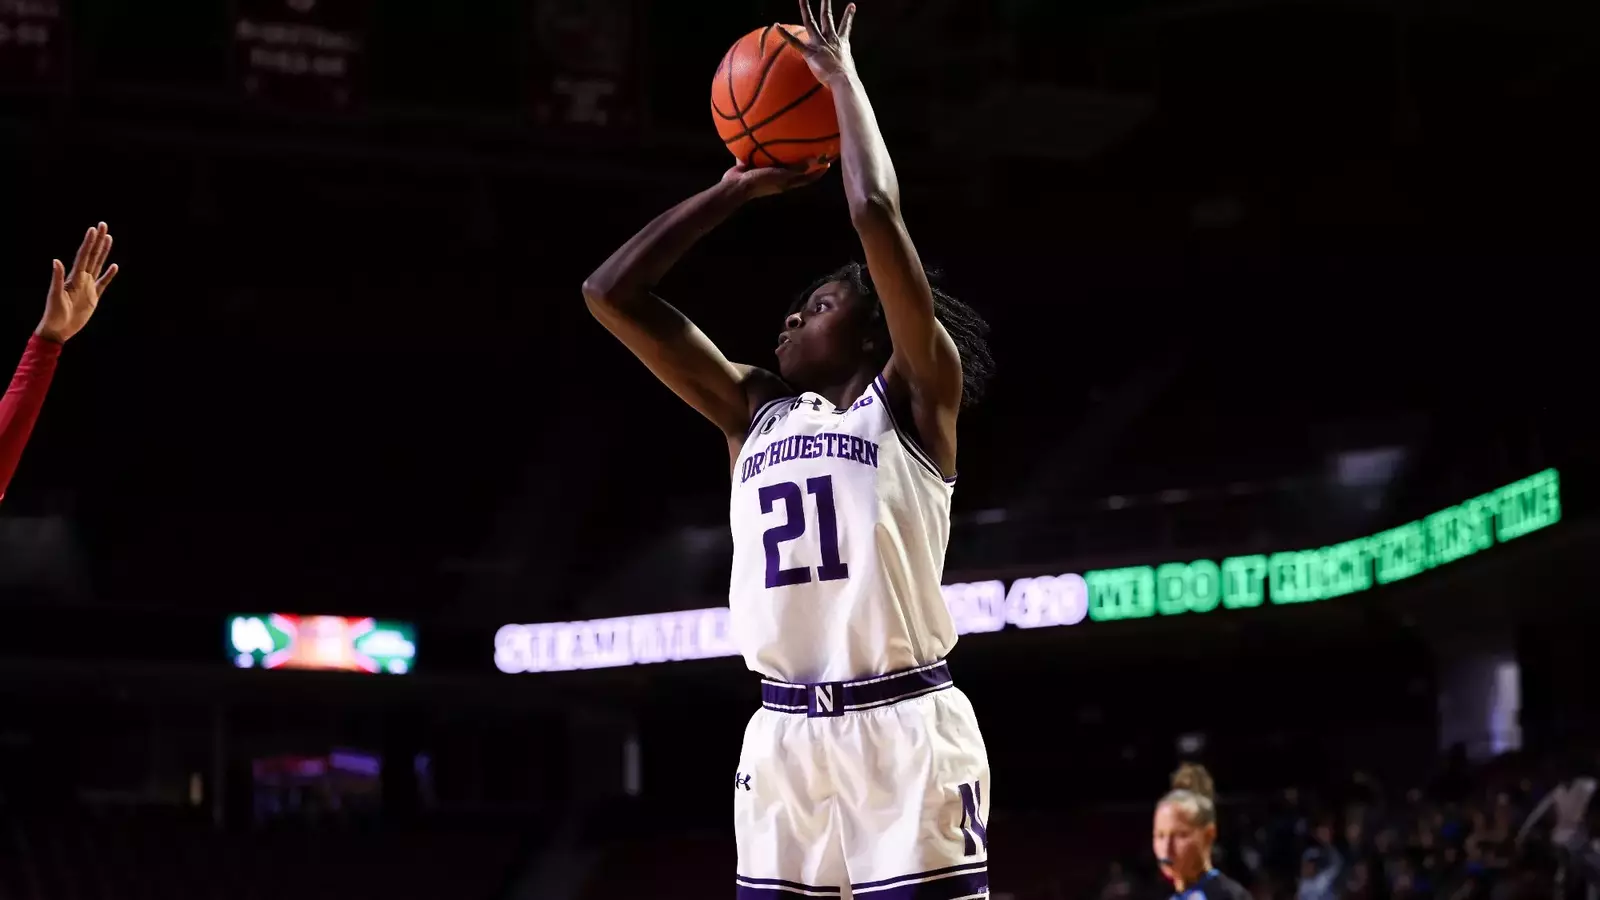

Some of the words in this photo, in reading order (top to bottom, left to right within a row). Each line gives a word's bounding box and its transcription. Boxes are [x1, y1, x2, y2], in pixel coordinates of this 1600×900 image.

[741, 432, 879, 484] ORHWESTERN
[758, 474, 849, 588] 21
[1156, 559, 1221, 615] DO
[816, 684, 833, 713] N
